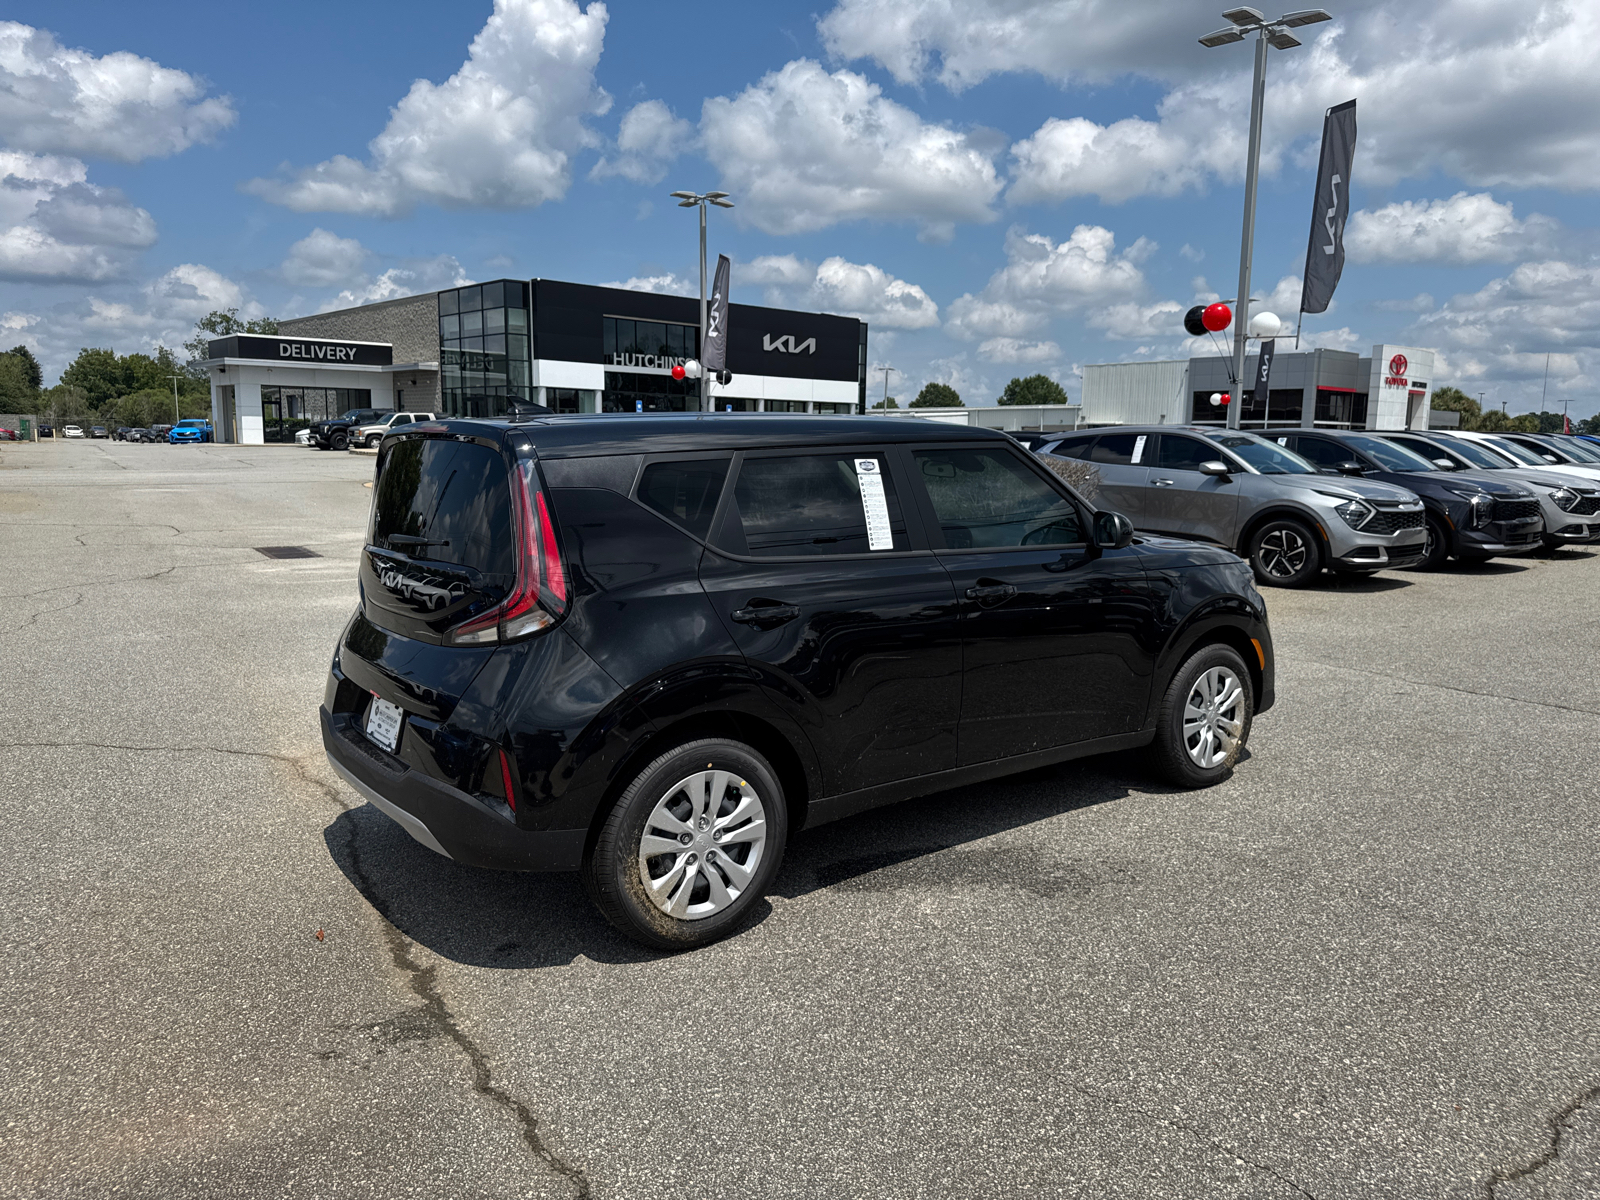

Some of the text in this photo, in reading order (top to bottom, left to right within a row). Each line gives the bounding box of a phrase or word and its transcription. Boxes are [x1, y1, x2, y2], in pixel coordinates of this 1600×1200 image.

[280, 343, 357, 360] DELIVERY
[763, 333, 816, 355] KIA
[613, 352, 699, 371] HUTCHINS
[1384, 376, 1408, 387] TOYOTA
[380, 569, 403, 589] KIA
